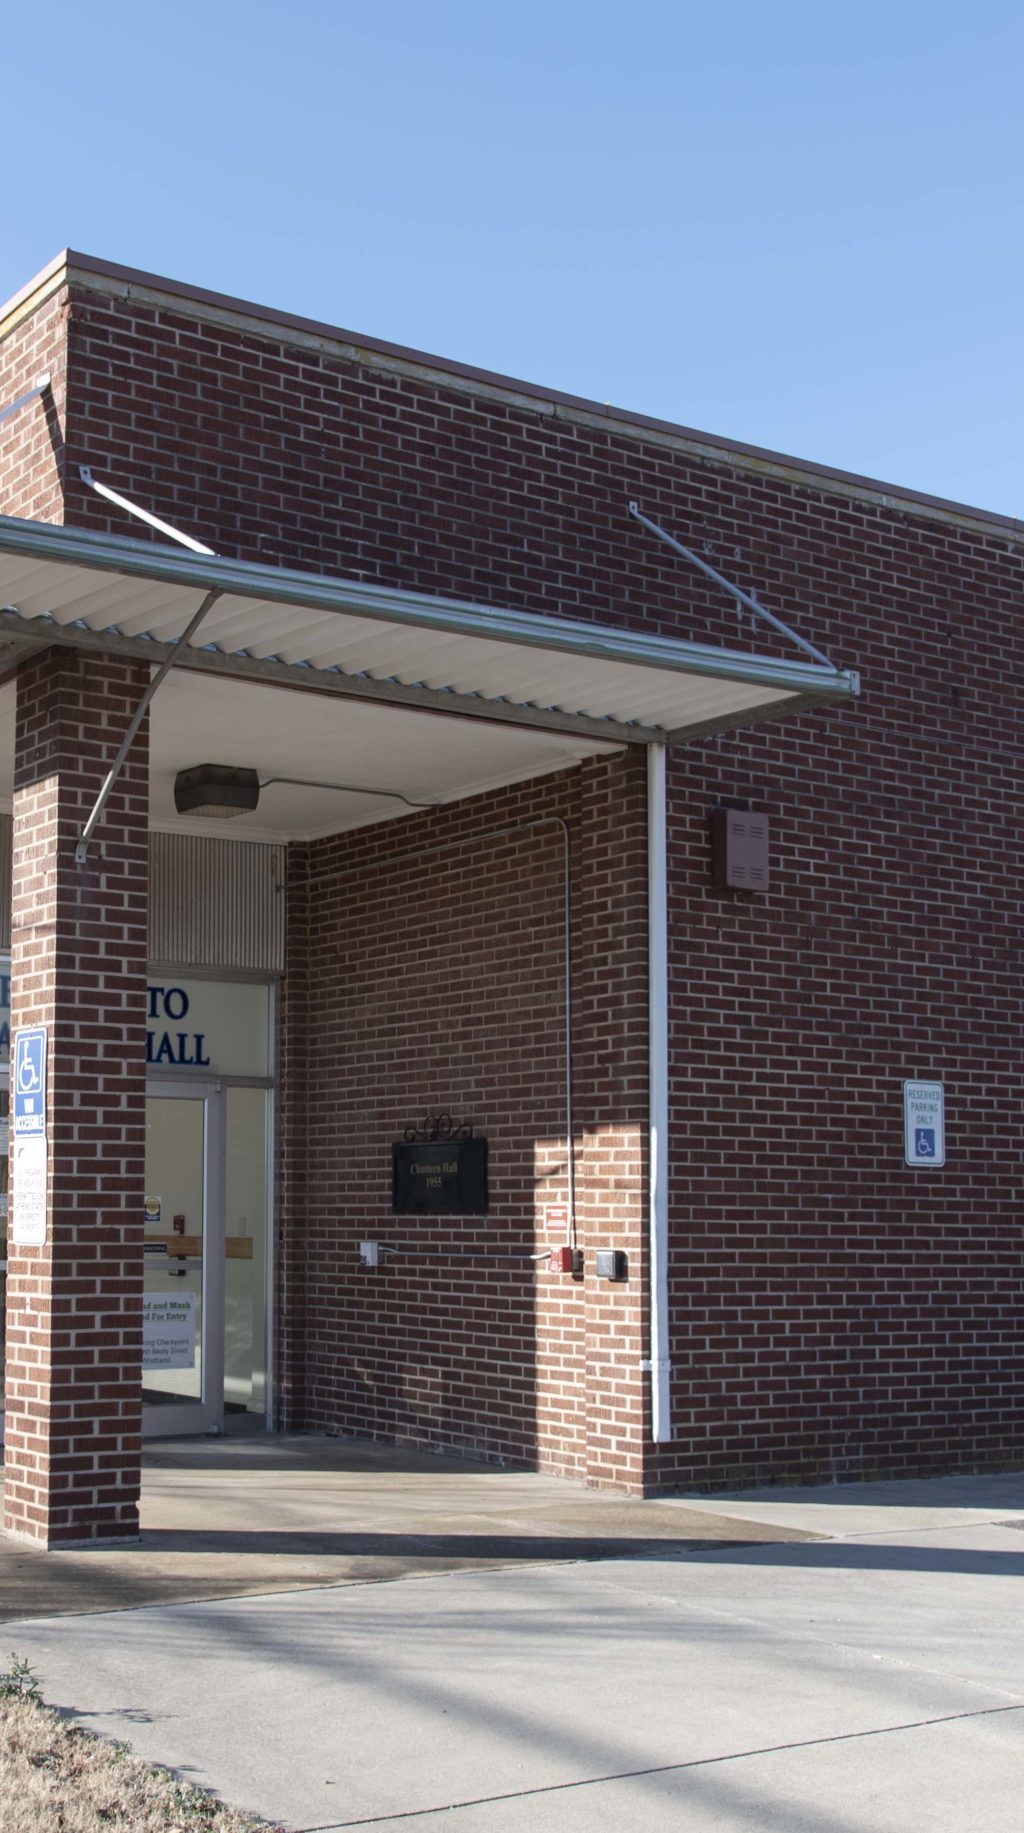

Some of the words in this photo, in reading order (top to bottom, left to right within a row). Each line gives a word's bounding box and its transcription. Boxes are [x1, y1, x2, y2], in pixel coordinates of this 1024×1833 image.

[147, 985, 189, 1020] TO
[908, 1089, 941, 1101] RESERVED
[911, 1102, 938, 1113] PARKING
[15, 1114, 43, 1130] ACCESSIBLE
[916, 1114, 933, 1125] ONLY
[442, 1161, 458, 1173] Hall
[426, 1176, 442, 1188] 1955
[153, 1301, 167, 1309] and
[169, 1301, 191, 1309] Mask
[152, 1312, 165, 1320] For
[166, 1312, 187, 1321] Entry
[156, 1338, 189, 1346] Checkpoint
[170, 1346, 188, 1354] Street
